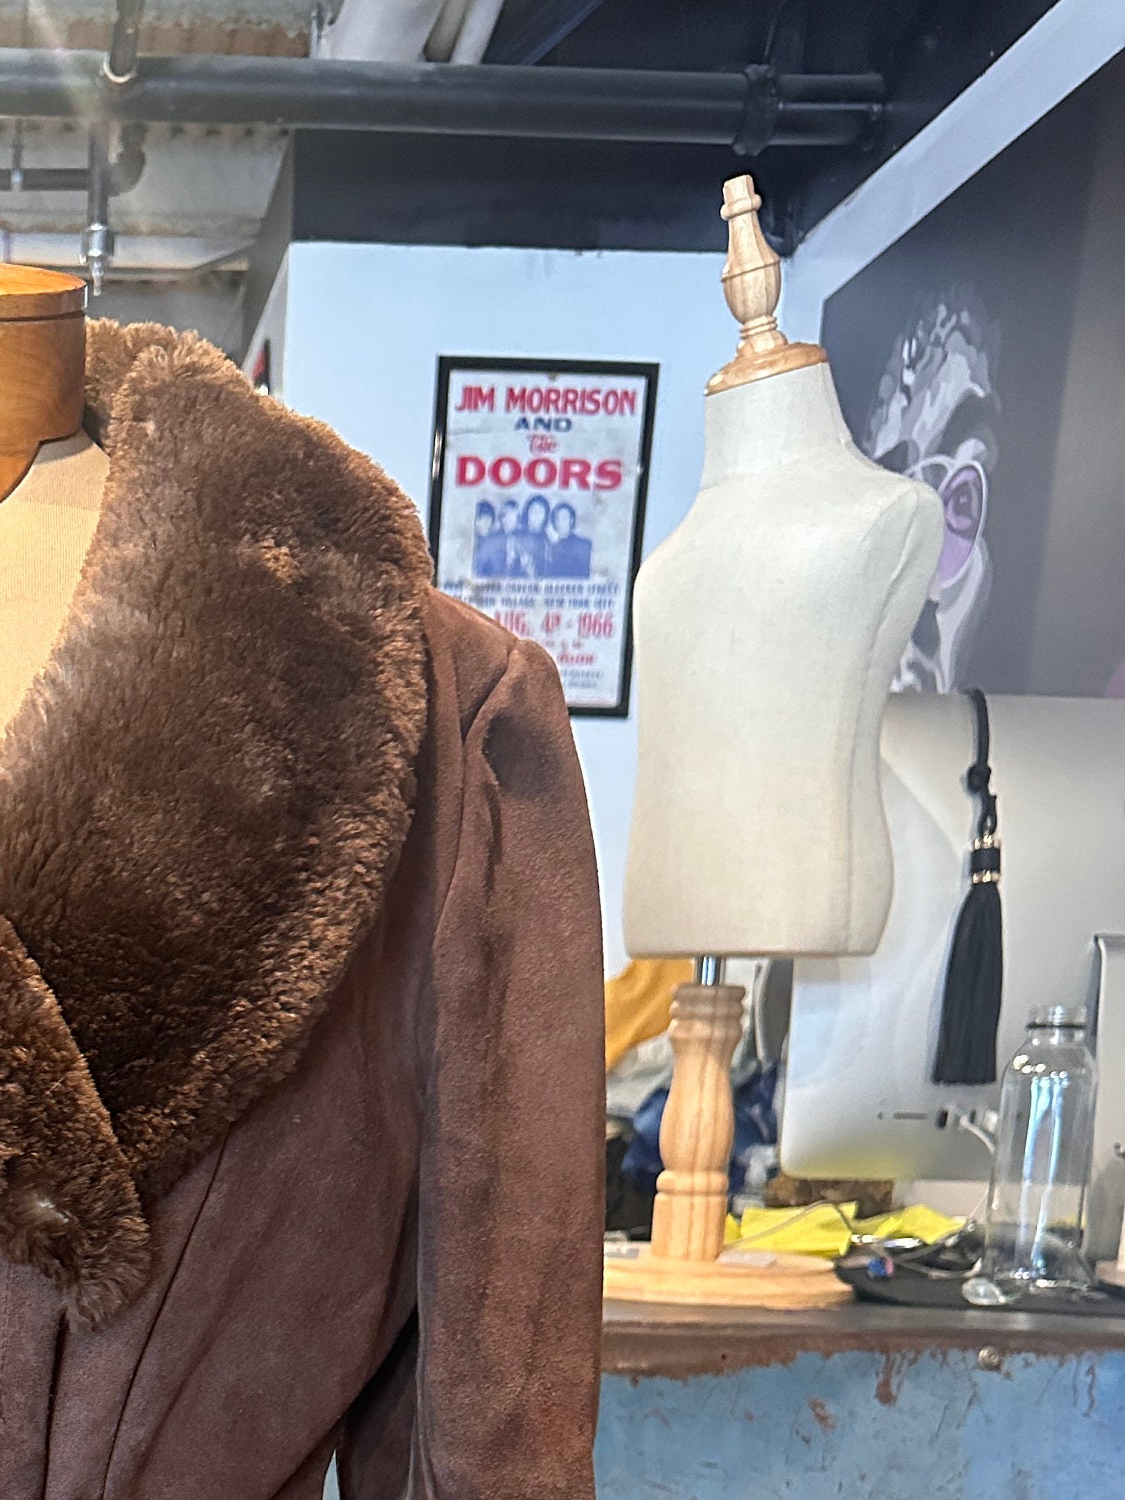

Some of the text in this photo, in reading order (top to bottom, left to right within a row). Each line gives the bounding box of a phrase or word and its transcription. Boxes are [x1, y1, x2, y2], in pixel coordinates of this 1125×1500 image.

[455, 385, 637, 416] JIM MORRISON
[514, 417, 572, 432] AND
[456, 455, 623, 490] DOORS
[578, 610, 613, 637] 1966
